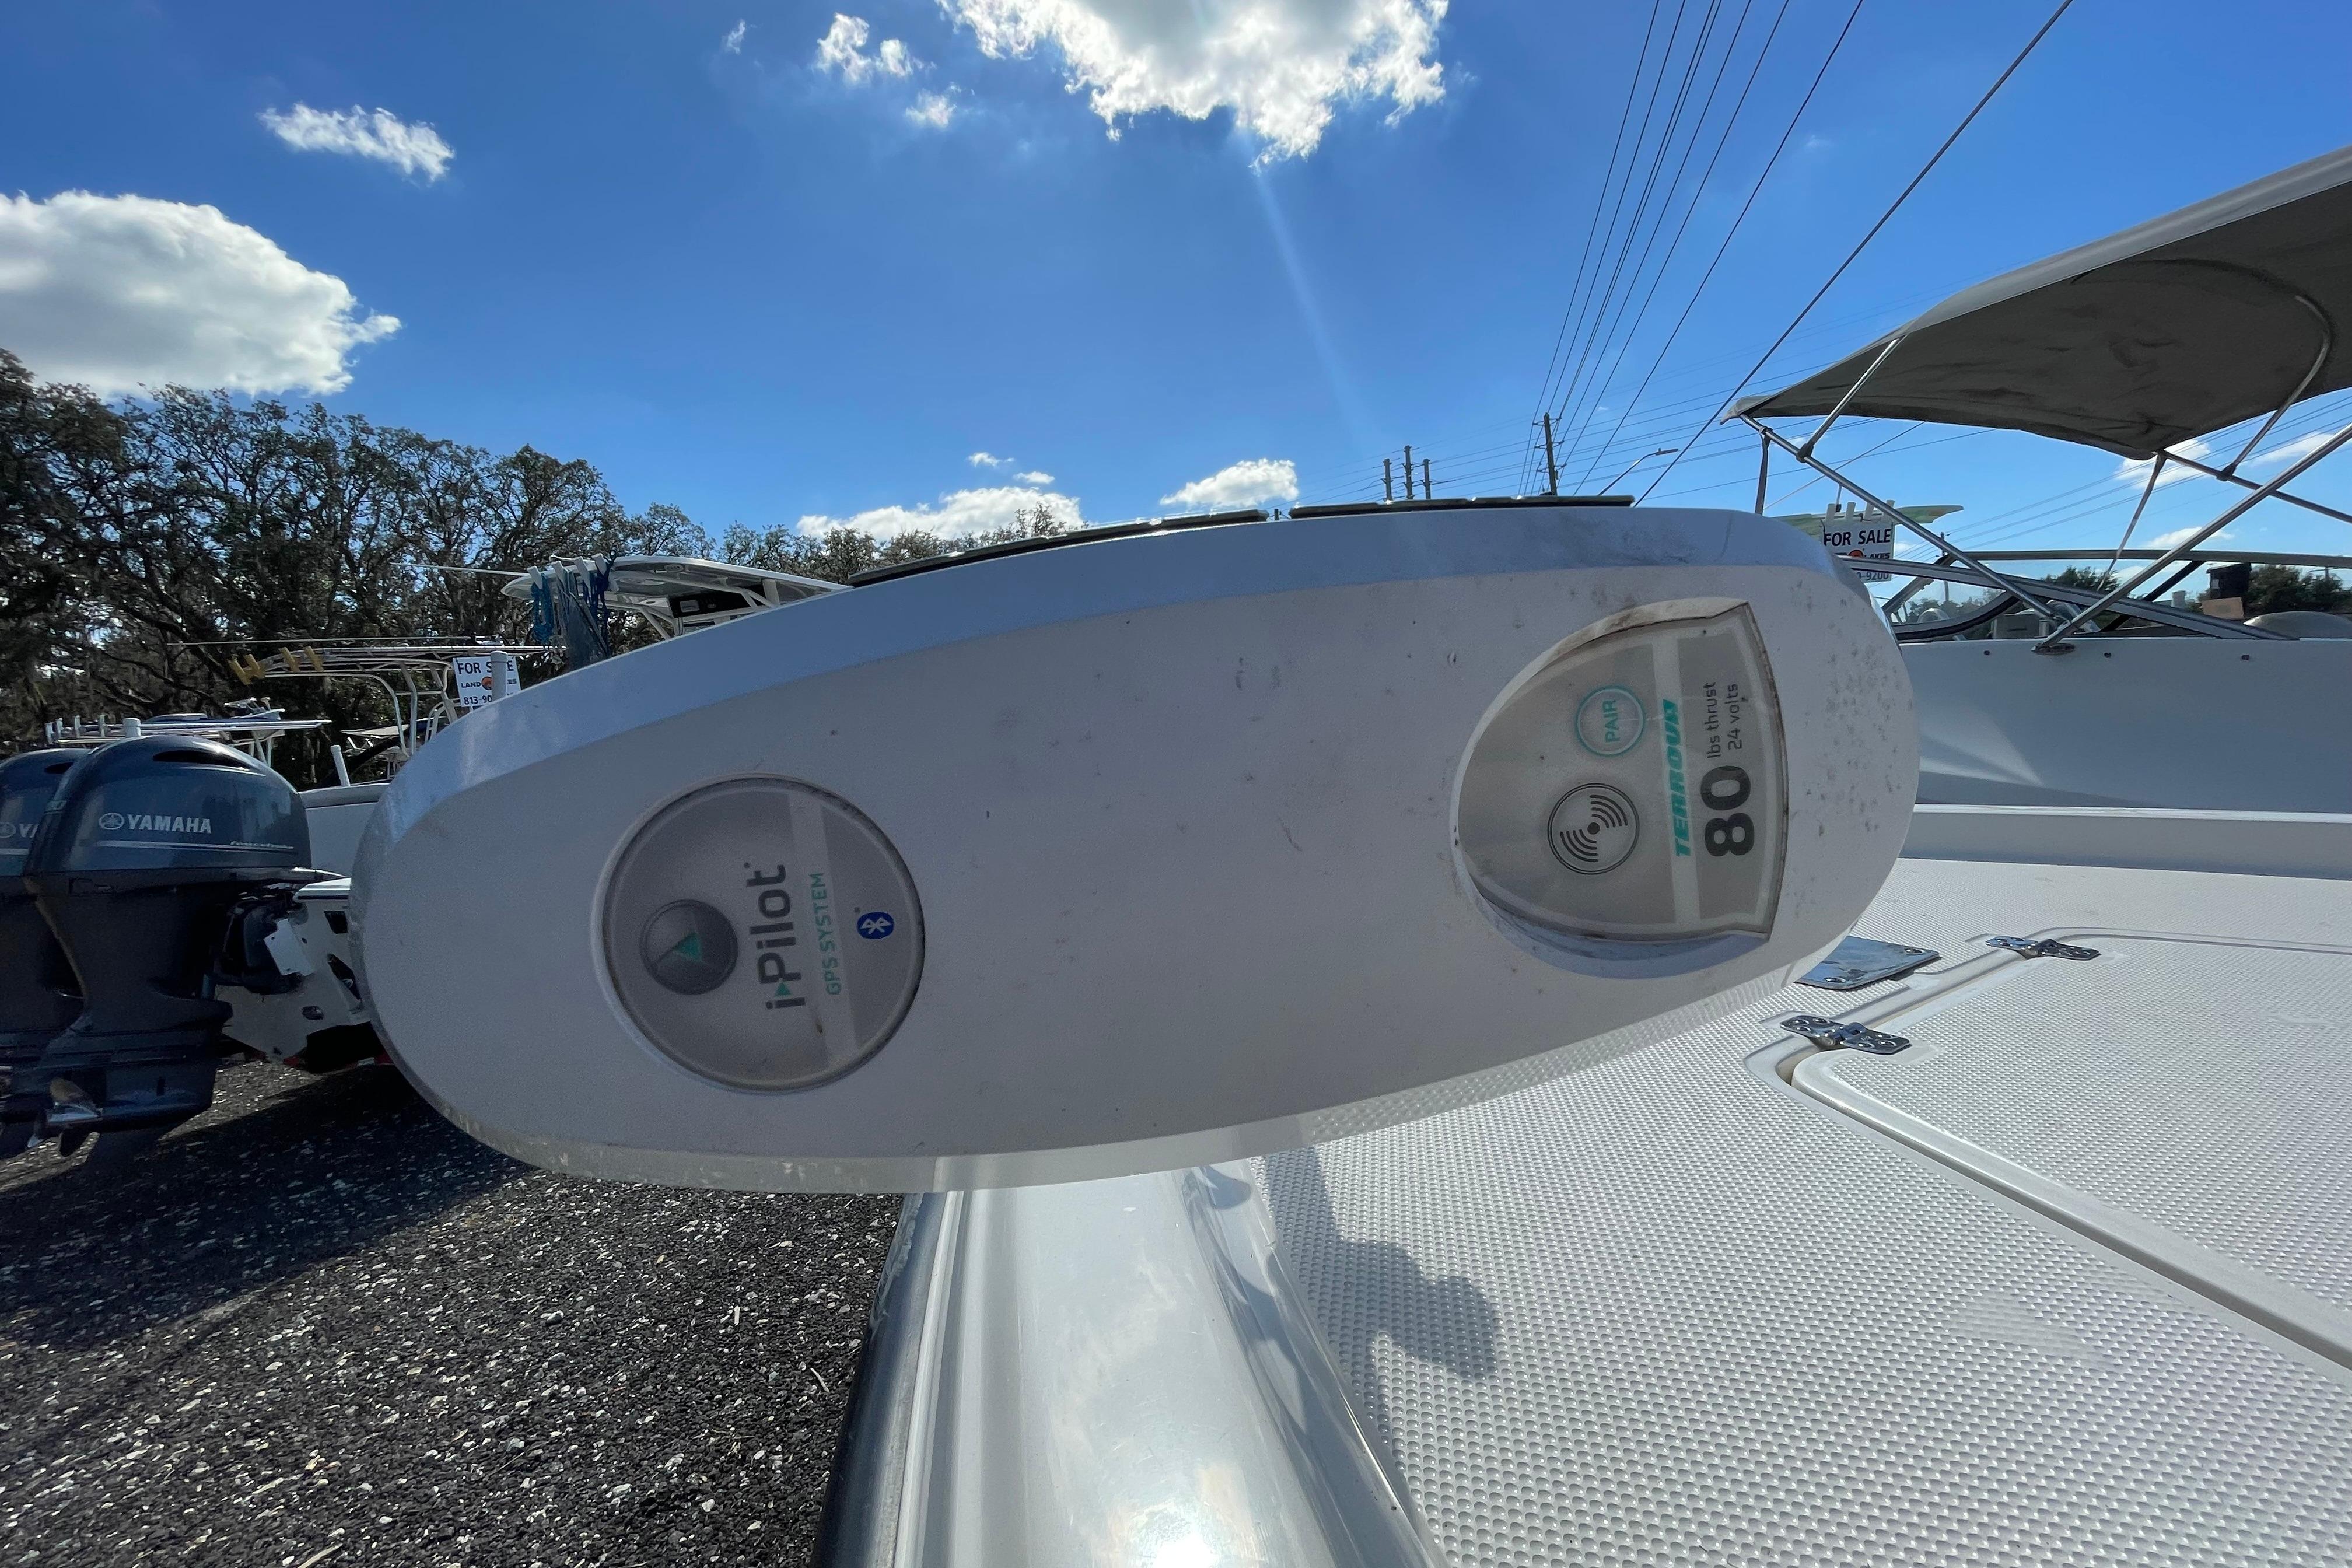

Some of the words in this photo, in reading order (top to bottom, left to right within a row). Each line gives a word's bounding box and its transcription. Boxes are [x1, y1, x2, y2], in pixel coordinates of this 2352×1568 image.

[1824, 531, 1852, 547] FOR
[1857, 528, 1891, 545] SALE
[457, 662, 482, 675] FOR
[486, 660, 514, 674] SE
[1602, 700, 1620, 743] PAIR
[1703, 681, 1719, 731] thrust
[1724, 683, 1740, 723] volts
[1706, 734, 1721, 758] lbs
[1727, 727, 1743, 751] 24
[1662, 699, 1690, 858] TERROVA
[127, 814, 212, 834] YAMAHA
[1700, 765, 1755, 858] 80
[808, 872, 835, 952] SYSTEM
[821, 957, 842, 995] GPS
